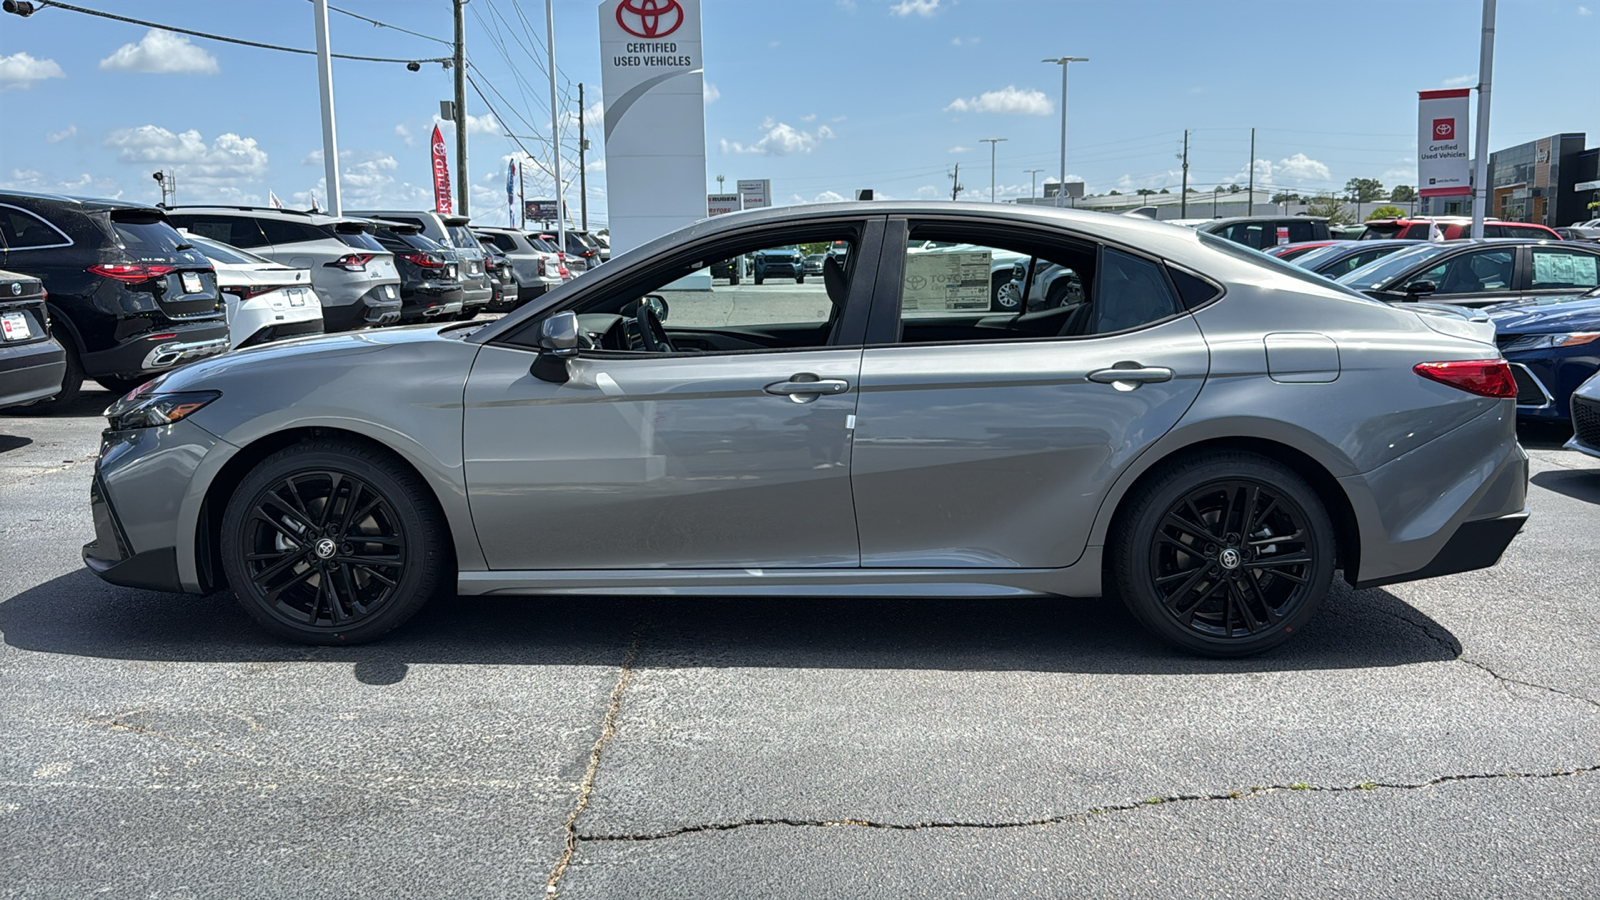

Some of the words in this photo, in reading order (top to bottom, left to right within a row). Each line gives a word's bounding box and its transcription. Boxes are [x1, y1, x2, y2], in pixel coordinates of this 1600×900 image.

[626, 42, 677, 53] CERTIFIED
[613, 56, 641, 66] USED
[643, 56, 691, 66] VEHICLES
[435, 159, 448, 211] RTIFIED
[930, 274, 962, 283] TOYO
